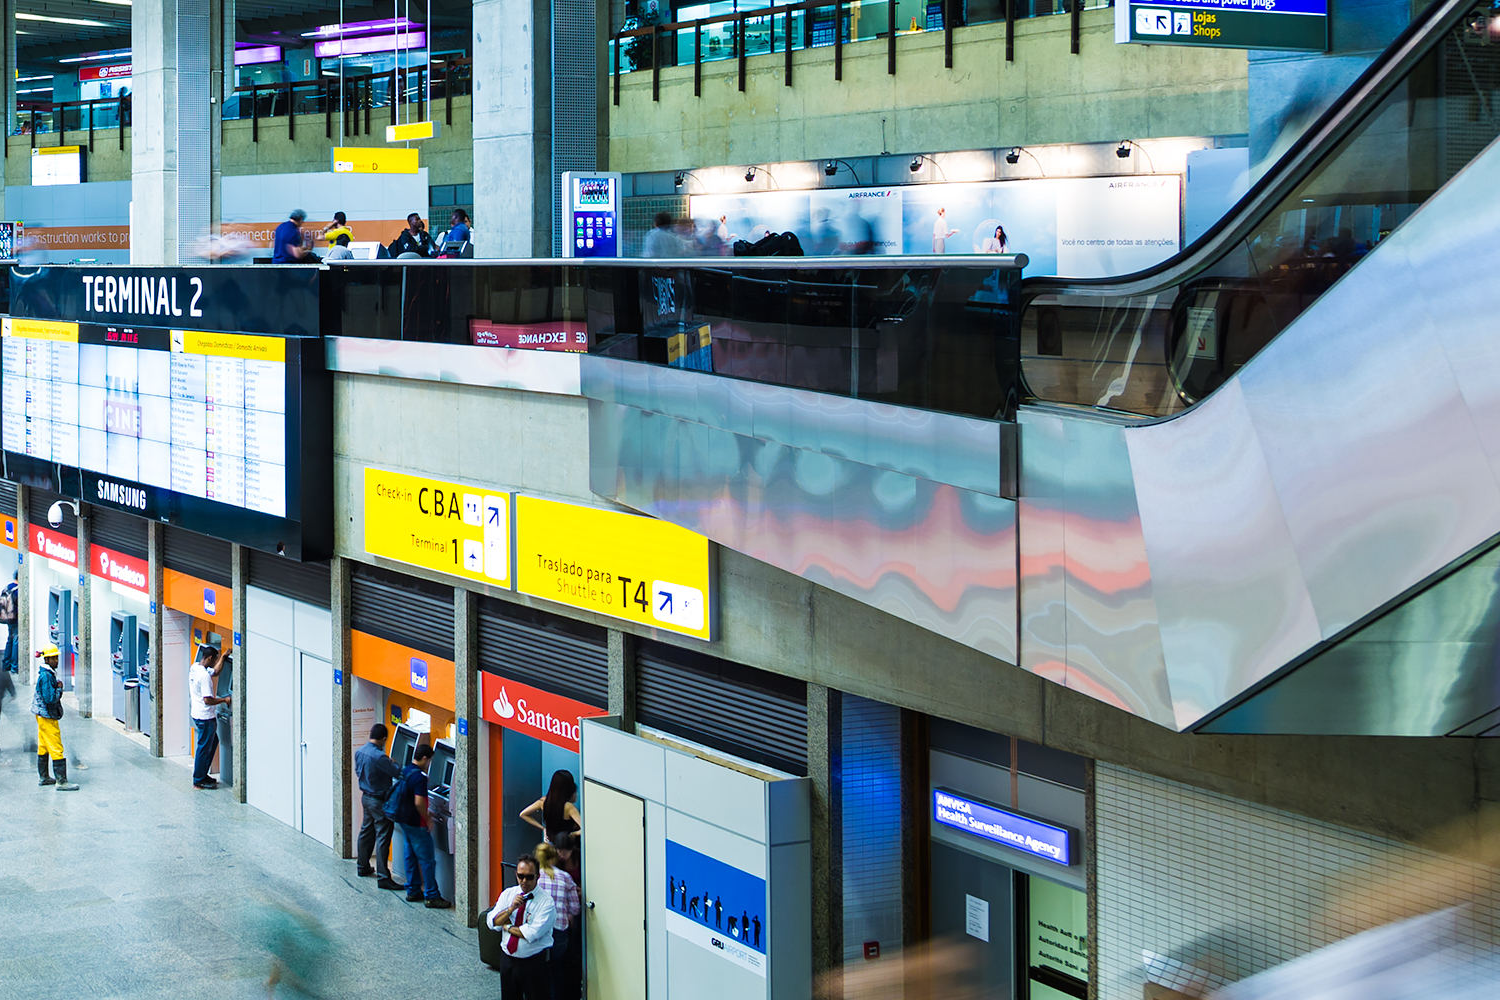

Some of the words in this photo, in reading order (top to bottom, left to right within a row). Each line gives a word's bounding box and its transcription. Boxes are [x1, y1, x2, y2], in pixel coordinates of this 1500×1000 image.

[1193, 11, 1217, 26] Lojas
[1193, 24, 1221, 39] Shops
[372, 163, 378, 171] D
[26, 231, 79, 244] Construction
[80, 232, 107, 243] works
[109, 233, 119, 243] to
[120, 233, 130, 245] pr
[1061, 237, 1076, 246] Você
[1086, 238, 1106, 246] centro
[1107, 238, 1115, 246] de
[1115, 238, 1134, 246] todas
[82, 275, 182, 317] TERMINAL
[189, 276, 203, 317] 2
[97, 479, 147, 510] SAMSUNG
[376, 483, 412, 503] Check-in
[45, 538, 76, 563] Bradesco
[411, 533, 448, 554] Terminal
[451, 538, 459, 565] 1
[109, 560, 146, 588] Bradesco
[537, 553, 583, 578] Traslado
[586, 568, 612, 585] para
[556, 578, 598, 602] Shuttle
[600, 589, 613, 605] to
[617, 575, 649, 613] T4
[412, 671, 427, 688] Itaú
[937, 794, 972, 815] ANVISA
[938, 806, 968, 825] Health
[969, 816, 1025, 846] Surveillance
[1025, 835, 1061, 859] Agency
[1038, 920, 1059, 933] Health
[1039, 935, 1068, 952] Autoridad
